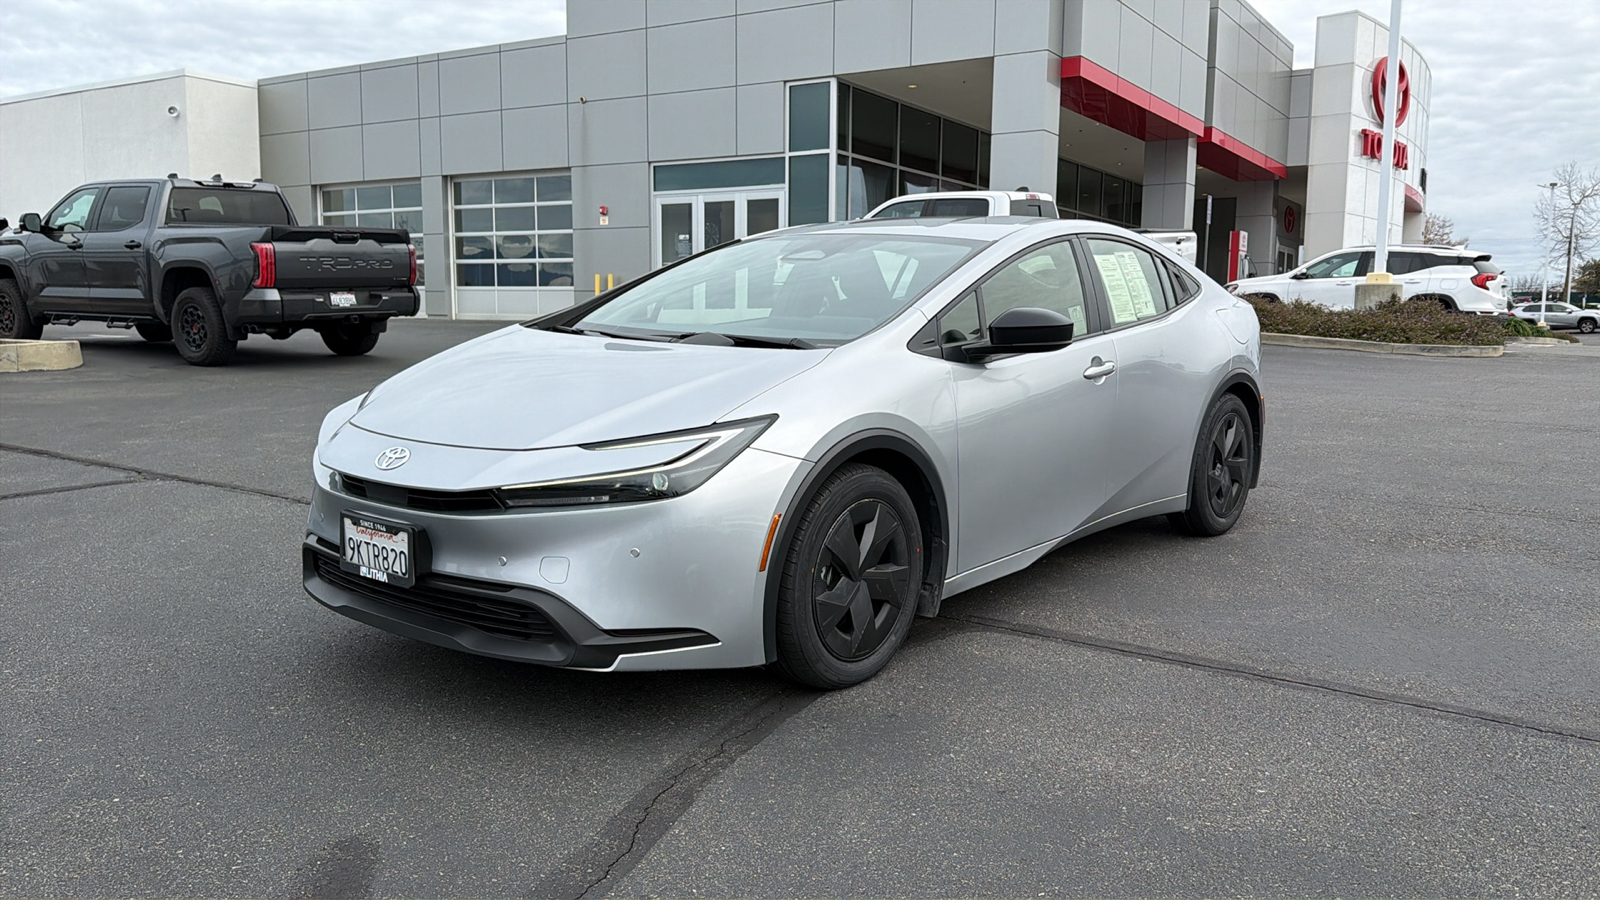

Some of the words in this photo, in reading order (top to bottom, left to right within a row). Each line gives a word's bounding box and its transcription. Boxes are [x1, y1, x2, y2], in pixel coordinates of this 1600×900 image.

[299, 256, 353, 272] TRD
[353, 259, 394, 269] PRO
[360, 519, 374, 529] SINCE
[347, 536, 408, 576] 9KTR820
